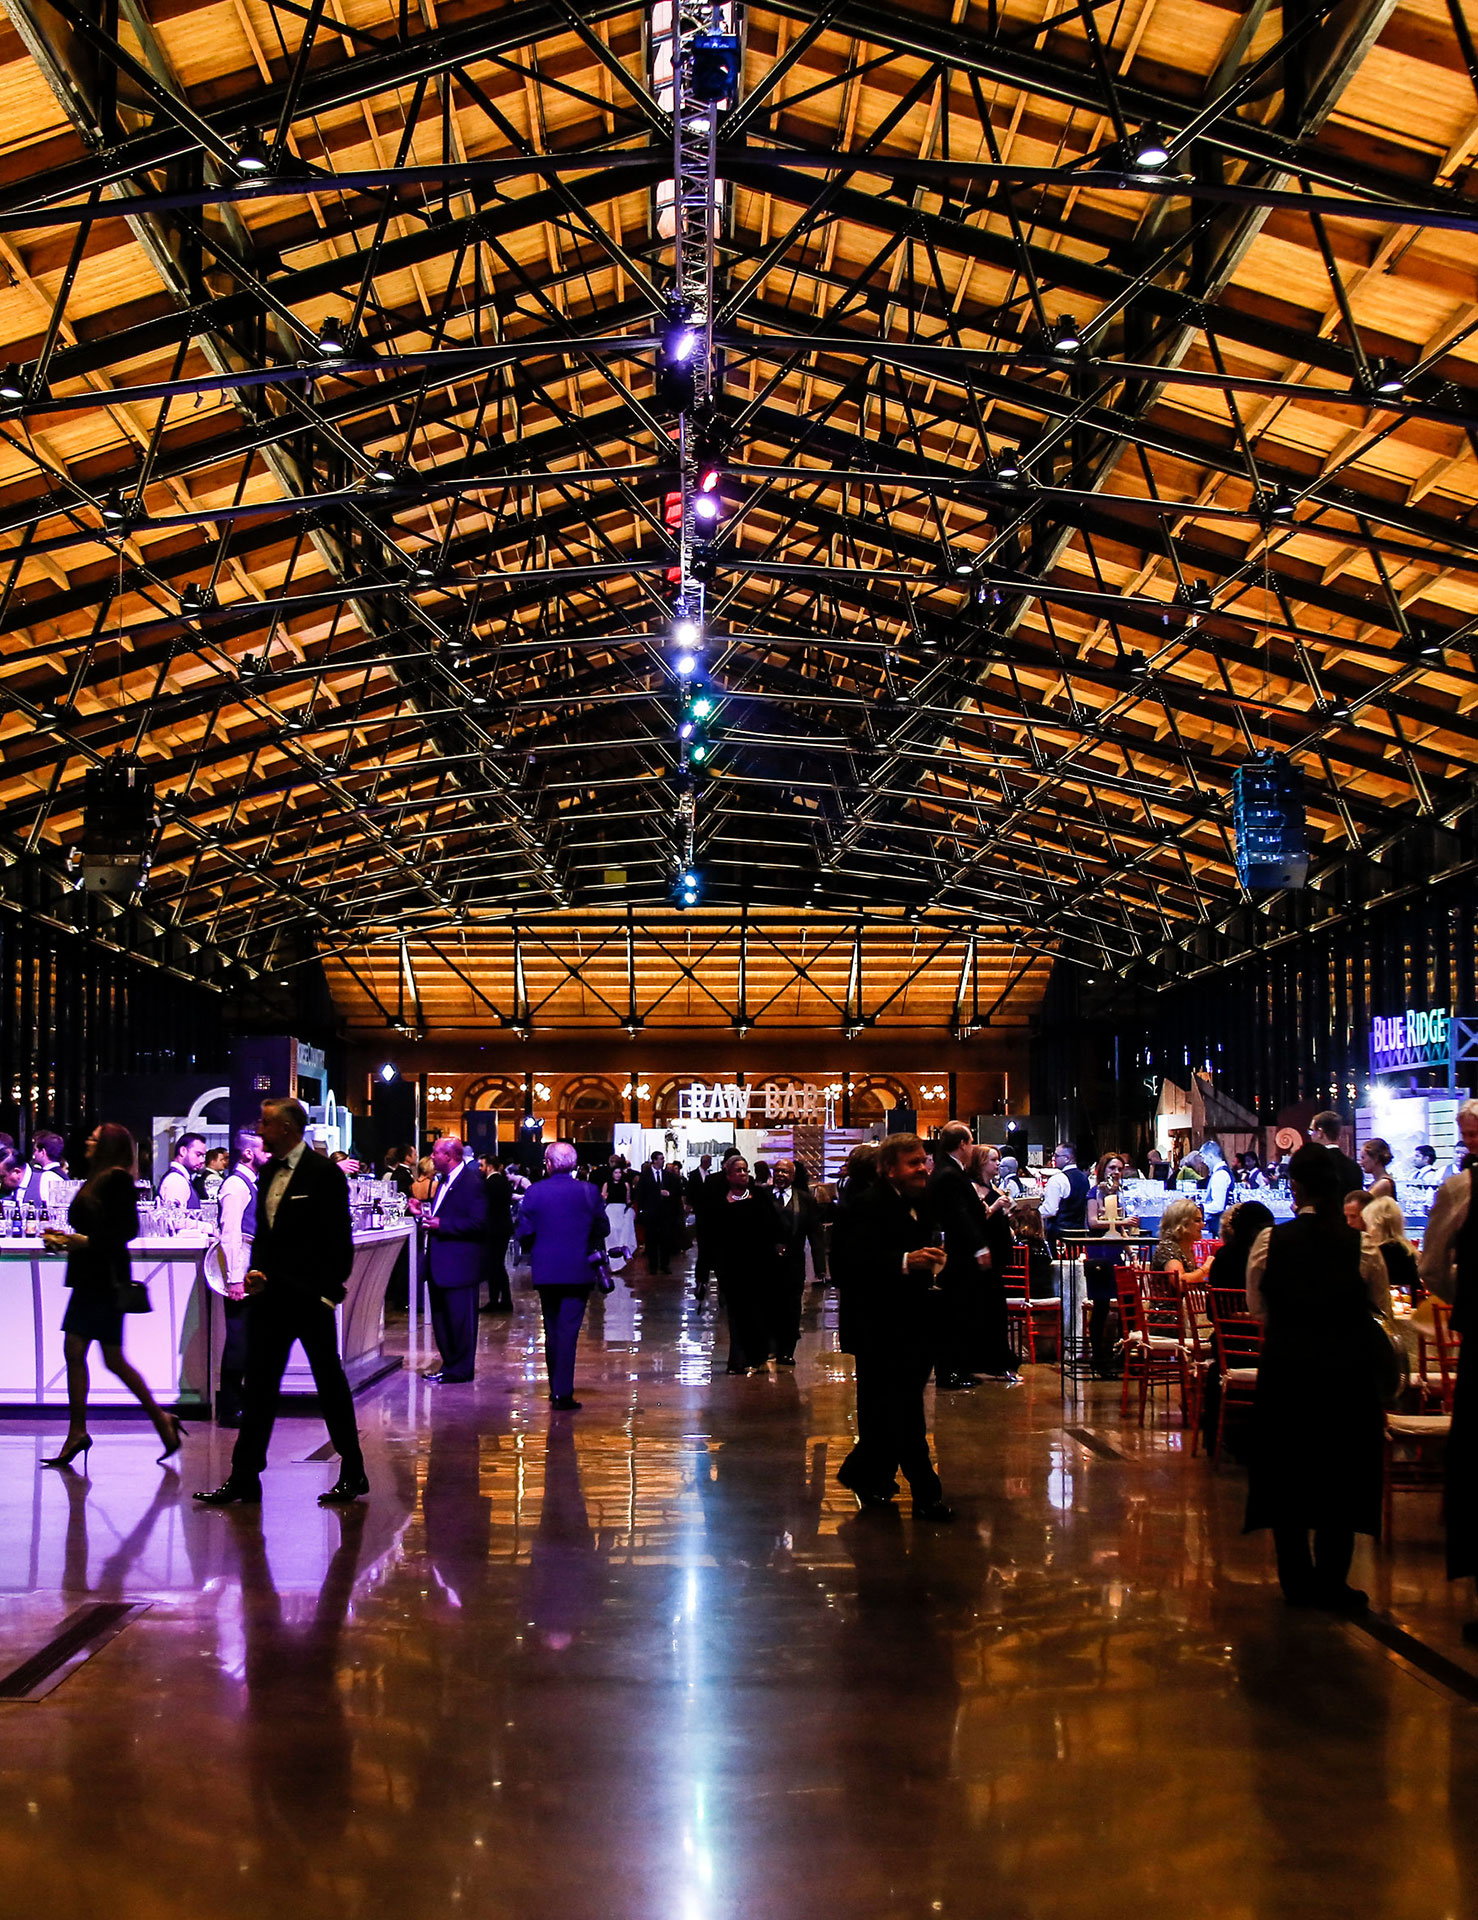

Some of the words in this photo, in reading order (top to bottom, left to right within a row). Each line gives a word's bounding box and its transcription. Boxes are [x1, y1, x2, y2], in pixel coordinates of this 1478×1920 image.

[1373, 1016, 1404, 1053] BLUE
[1406, 1008, 1446, 1048] RIDGE
[691, 1083, 752, 1118] RAW
[765, 1083, 818, 1118] BAR
